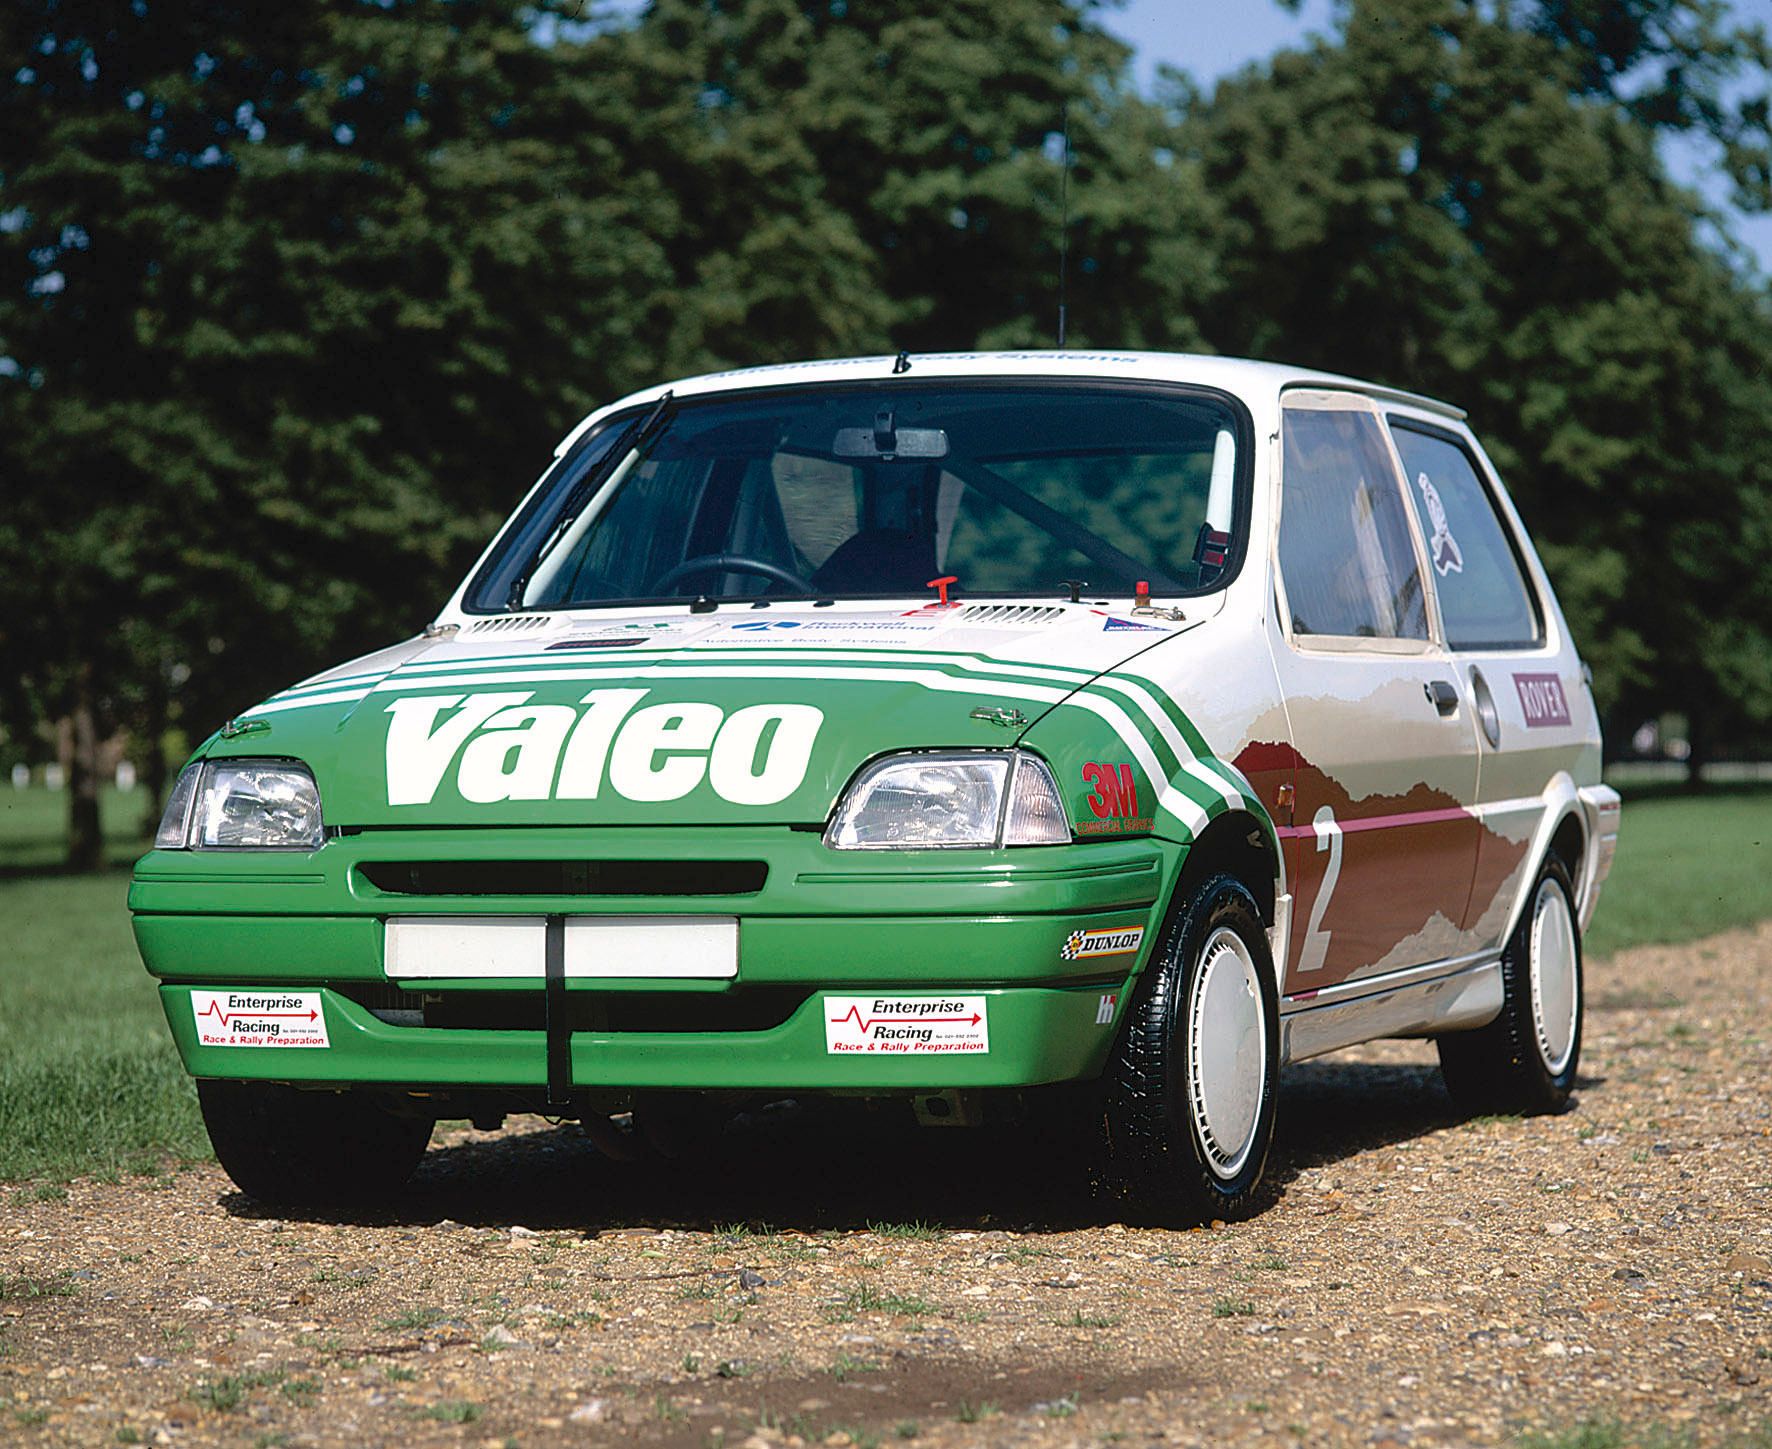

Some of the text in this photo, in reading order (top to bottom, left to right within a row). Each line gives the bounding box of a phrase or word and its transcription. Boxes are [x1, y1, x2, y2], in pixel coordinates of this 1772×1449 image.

[1518, 680, 1568, 719] ROVER
[384, 688, 825, 806] Valeo
[1081, 761, 1139, 818] 3M
[1296, 805, 1343, 972] 2
[1081, 933, 1140, 952] DUNLOP
[228, 994, 303, 1011] Enterprise
[872, 999, 965, 1016] Enterprise
[232, 1019, 280, 1036] Racing
[873, 1025, 933, 1043] Racing
[203, 1034, 325, 1046] Race & Rally Preparation
[833, 1041, 984, 1053] Race & Rally Preparation
